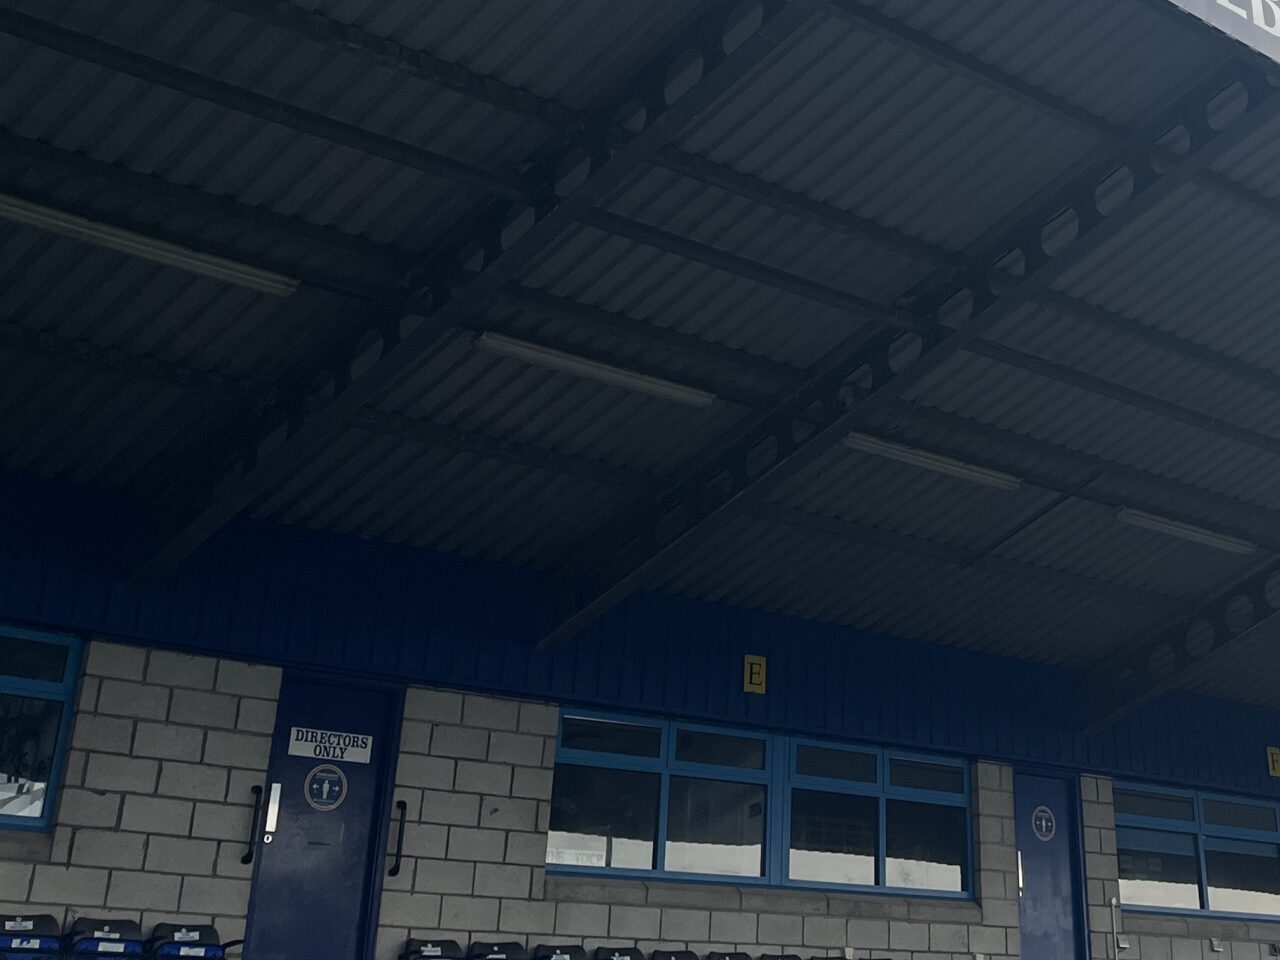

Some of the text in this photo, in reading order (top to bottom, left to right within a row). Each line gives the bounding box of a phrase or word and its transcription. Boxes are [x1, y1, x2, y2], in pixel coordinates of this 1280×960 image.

[747, 662, 763, 686] E
[294, 729, 369, 749] DIRECTORS
[313, 744, 348, 759] ONLY
[1270, 751, 1279, 771] F
